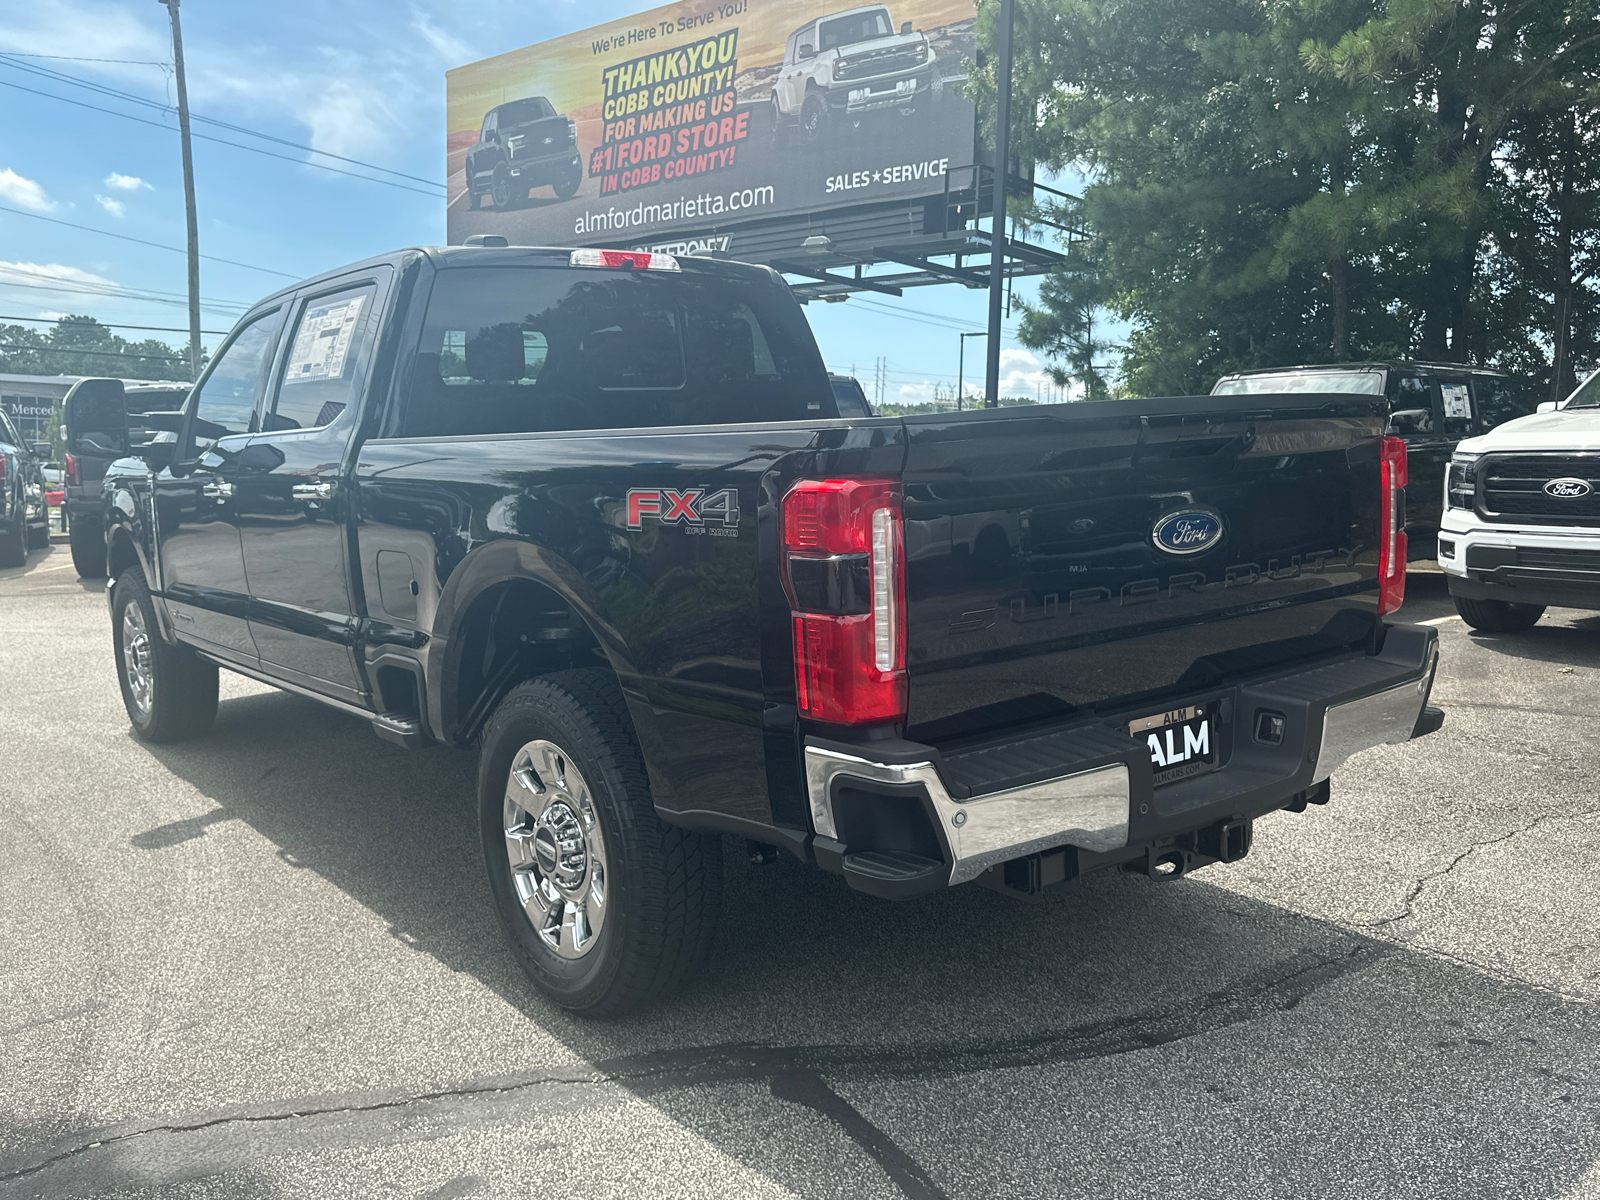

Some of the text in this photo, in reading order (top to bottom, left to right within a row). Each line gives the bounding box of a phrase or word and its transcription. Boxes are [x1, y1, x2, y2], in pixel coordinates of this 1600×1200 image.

[591, 0, 748, 55] We're Here To Serve You!
[605, 33, 735, 97] THANK YOU
[605, 65, 734, 119] COBB COUNTY!
[605, 91, 734, 143] FOR MAKING US
[591, 111, 750, 174] #1 FORD STORE
[602, 146, 736, 193] IN COBB COUNTY!
[825, 158, 949, 193] SALES SERVICE
[574, 185, 775, 234] almfordmarietta.com
[626, 487, 740, 531] FX4
[1552, 483, 1581, 496] Ford
[685, 527, 738, 537] OFF ROAD
[948, 543, 1365, 635] SUPER DUTY
[1163, 709, 1187, 725] ALM
[1147, 720, 1209, 767] ALM
[1154, 764, 1200, 784] ALMCARS.COM
